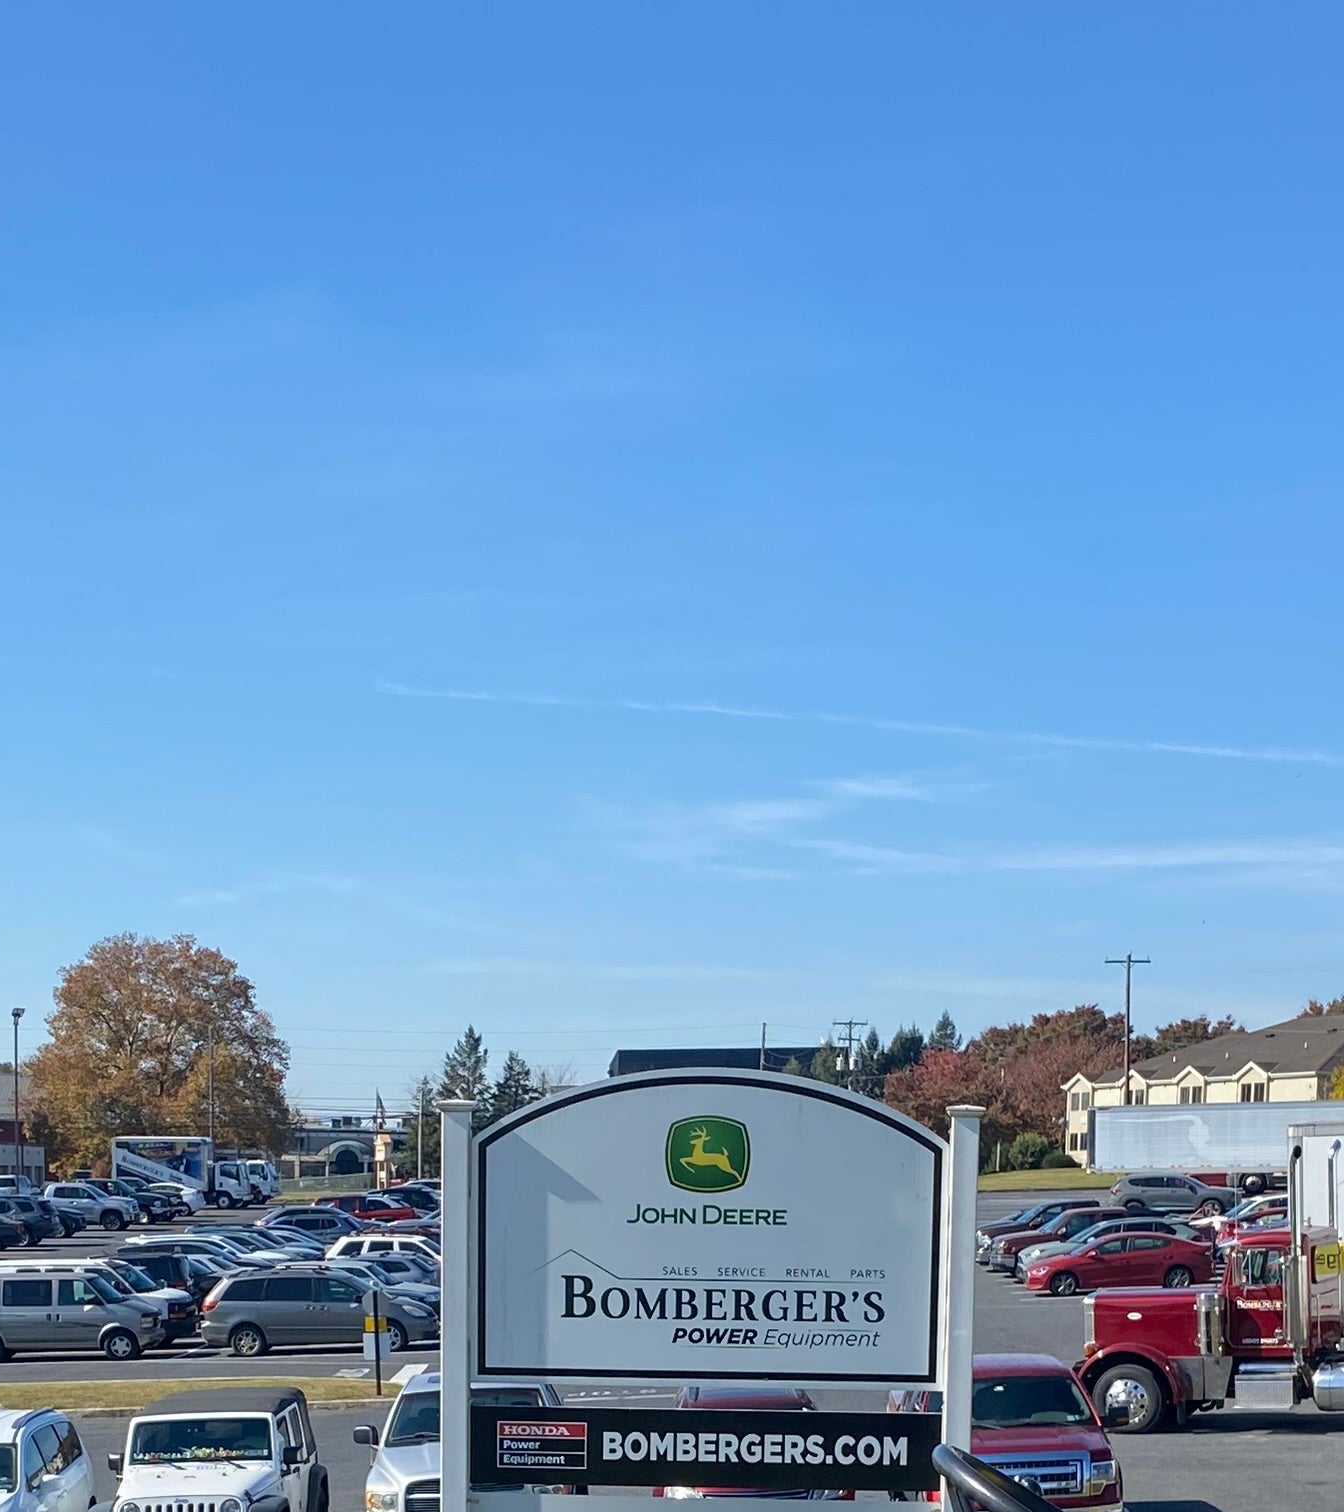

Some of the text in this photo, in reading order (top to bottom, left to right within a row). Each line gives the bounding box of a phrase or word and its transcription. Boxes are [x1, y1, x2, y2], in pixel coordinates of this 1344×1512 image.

[626, 1204, 788, 1226] JOHN DEERE
[662, 1266, 886, 1279] SALES SERVICE RENTAL PARTS
[560, 1274, 886, 1324] BOMBERGER'S
[672, 1327, 881, 1350] POWER Equipment
[503, 1424, 571, 1437] HONDA
[503, 1440, 541, 1451] Power
[602, 1431, 908, 1467] BOMBERGERS.COM
[503, 1454, 566, 1466] Equipment
